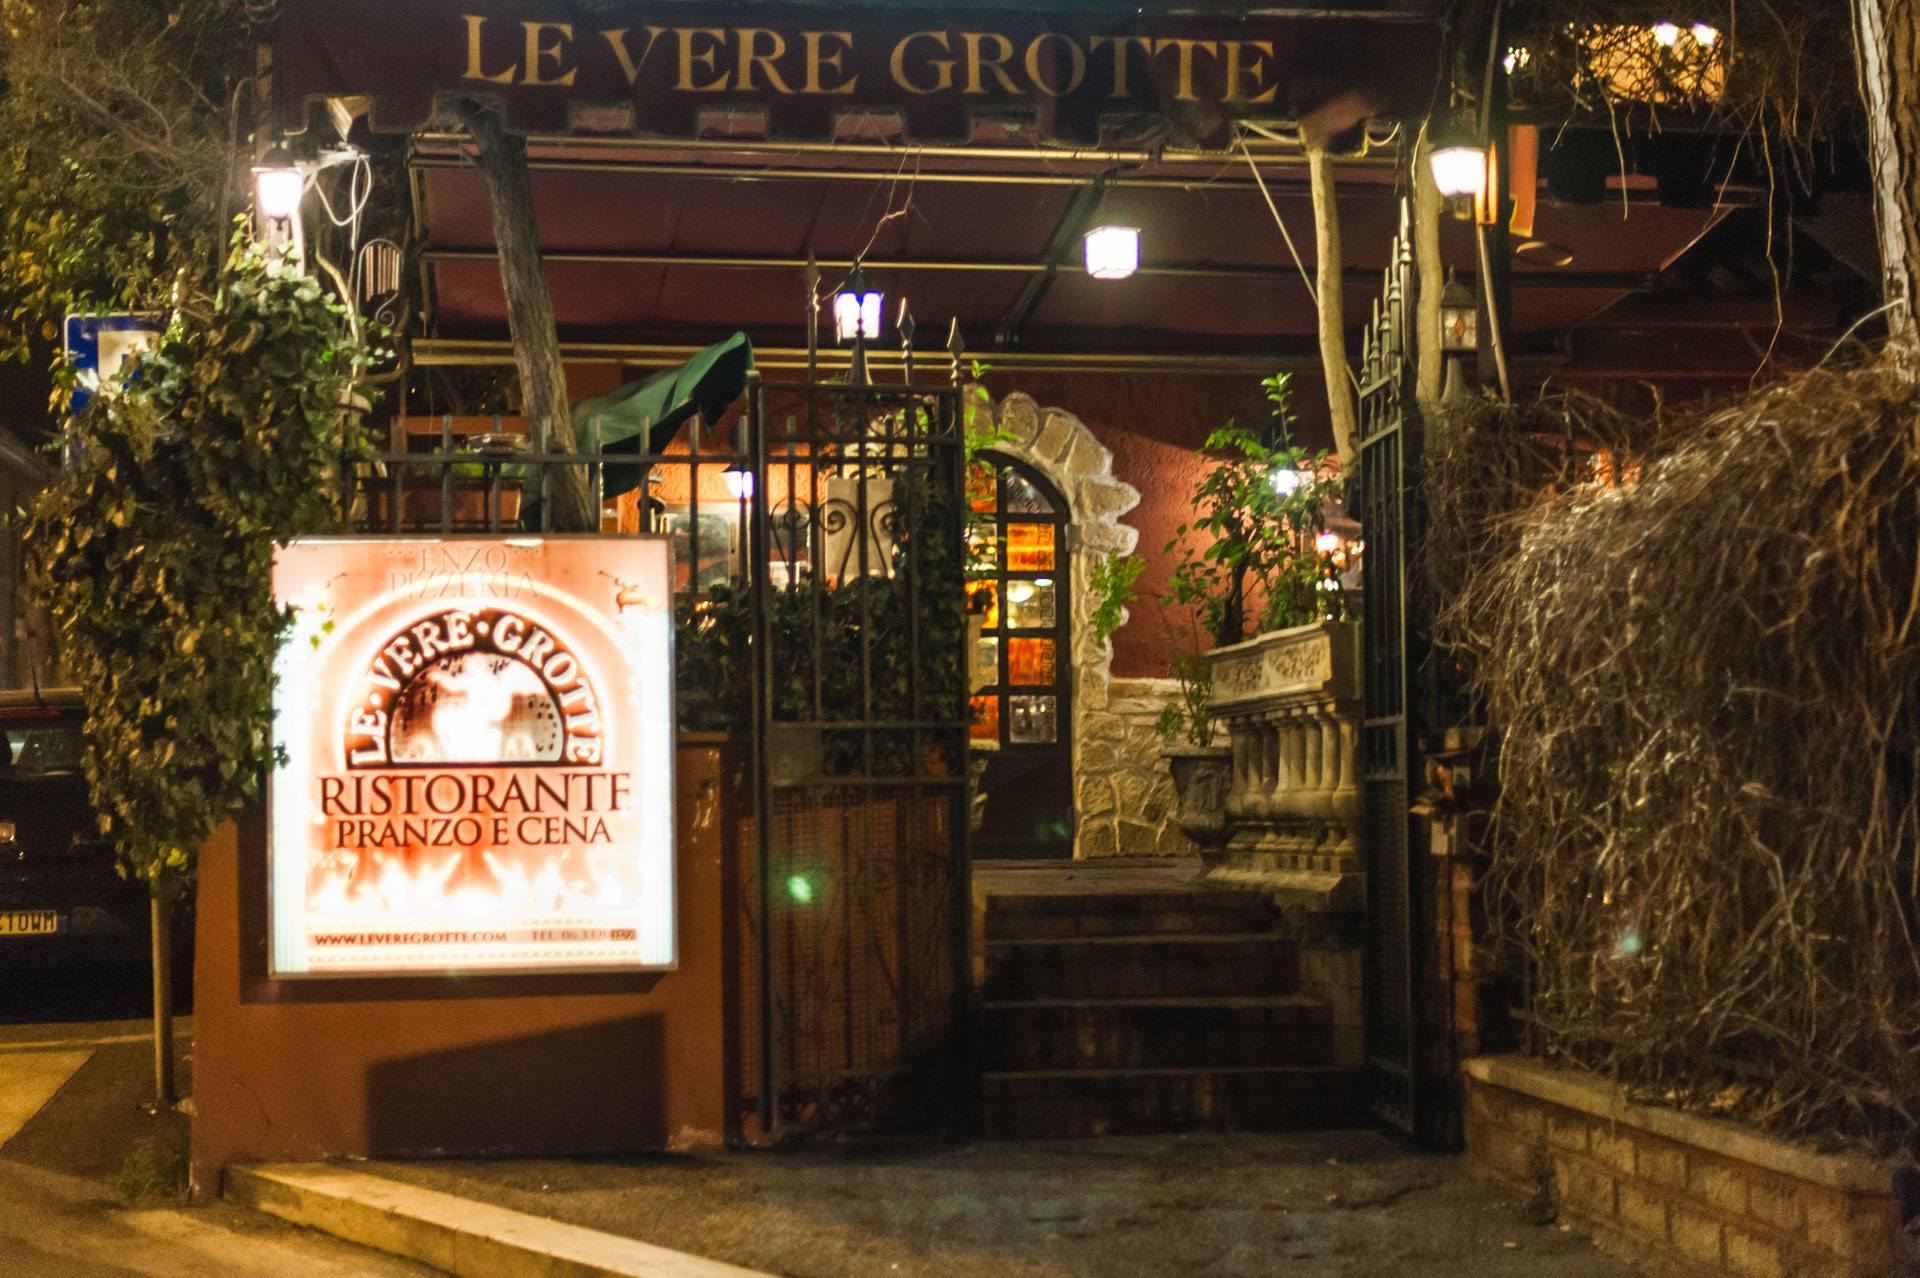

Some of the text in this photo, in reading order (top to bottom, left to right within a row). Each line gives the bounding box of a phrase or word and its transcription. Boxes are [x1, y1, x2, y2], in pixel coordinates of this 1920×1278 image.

[461, 14, 1279, 102] LE VERE GROTTE
[419, 547, 508, 572] ENZO
[390, 571, 540, 599] PIZZERIA
[350, 611, 601, 766] LE VERE GROTTE
[317, 772, 631, 816] RISTORANTE
[335, 814, 614, 849] PRANZO E CENA
